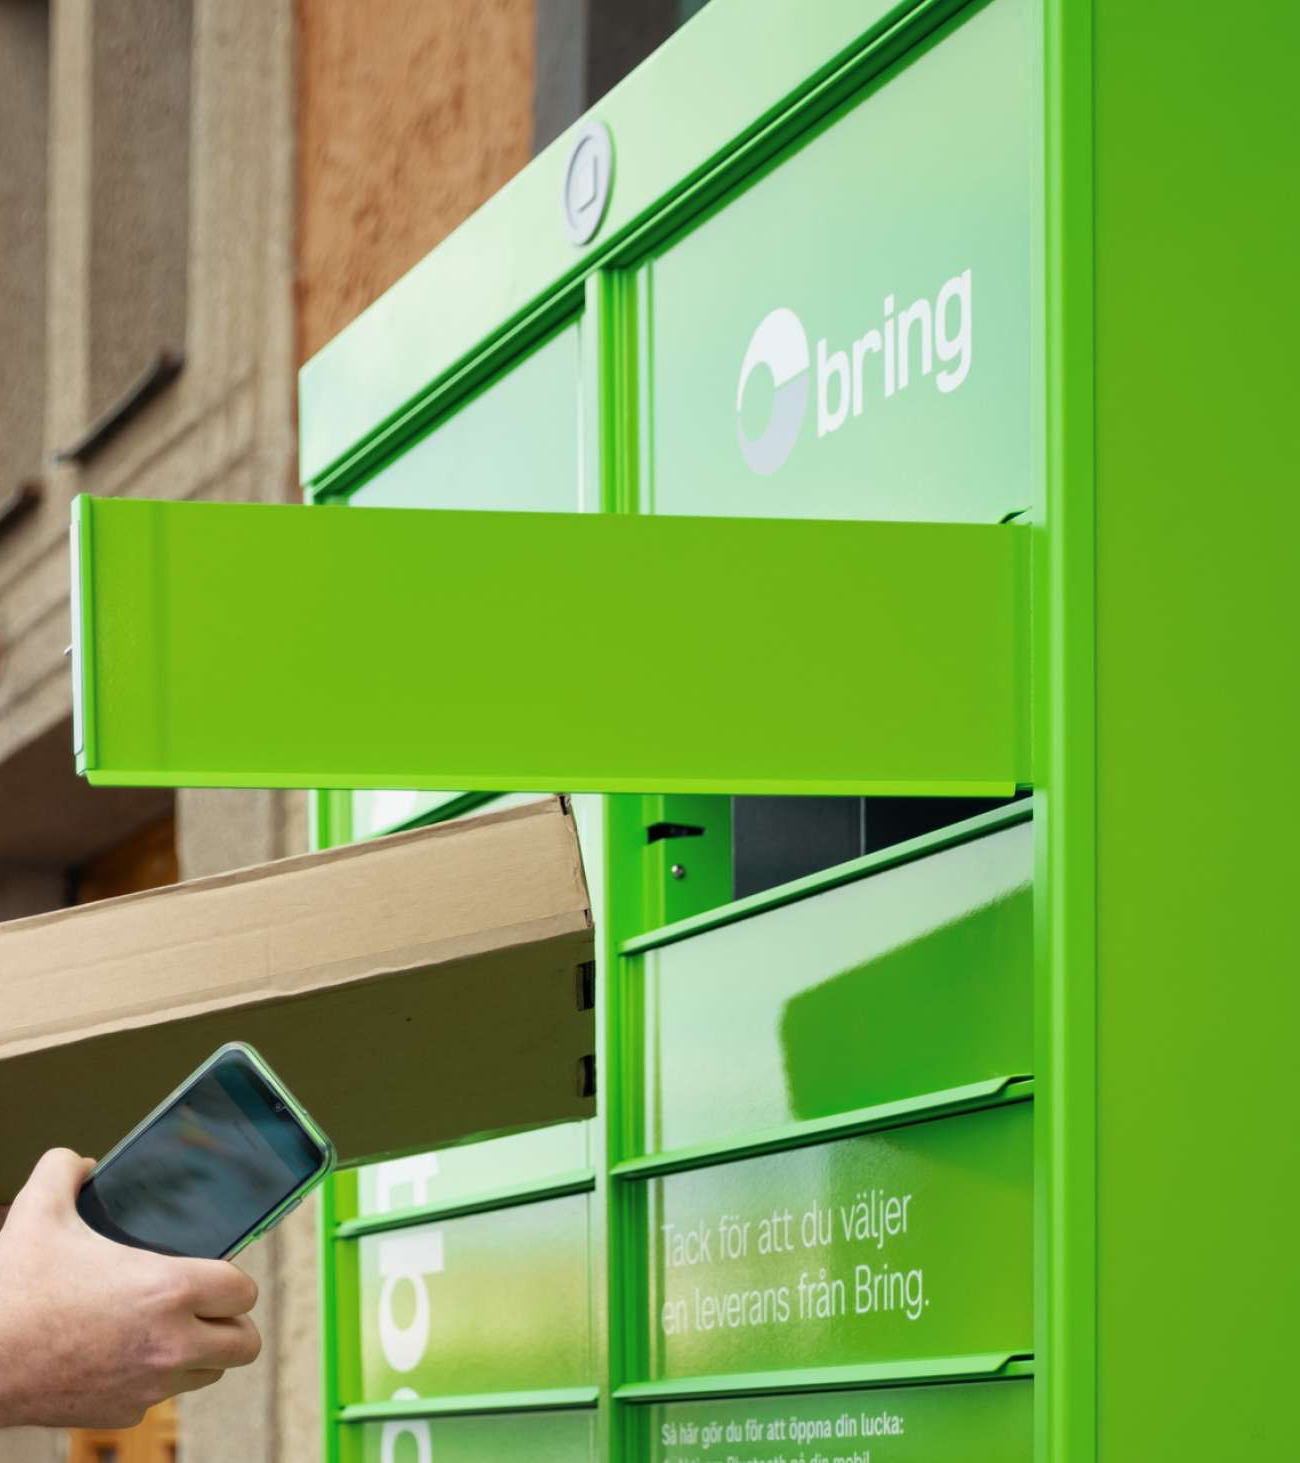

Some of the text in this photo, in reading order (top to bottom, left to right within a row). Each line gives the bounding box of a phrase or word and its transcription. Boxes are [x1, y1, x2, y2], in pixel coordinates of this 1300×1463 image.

[816, 267, 972, 438] bring
[661, 1189, 912, 1268] Tack för att du väljer
[661, 1263, 930, 1335] en leverans från Bring.
[661, 1410, 905, 1449] Så här gör du för att öppna din lucka:
